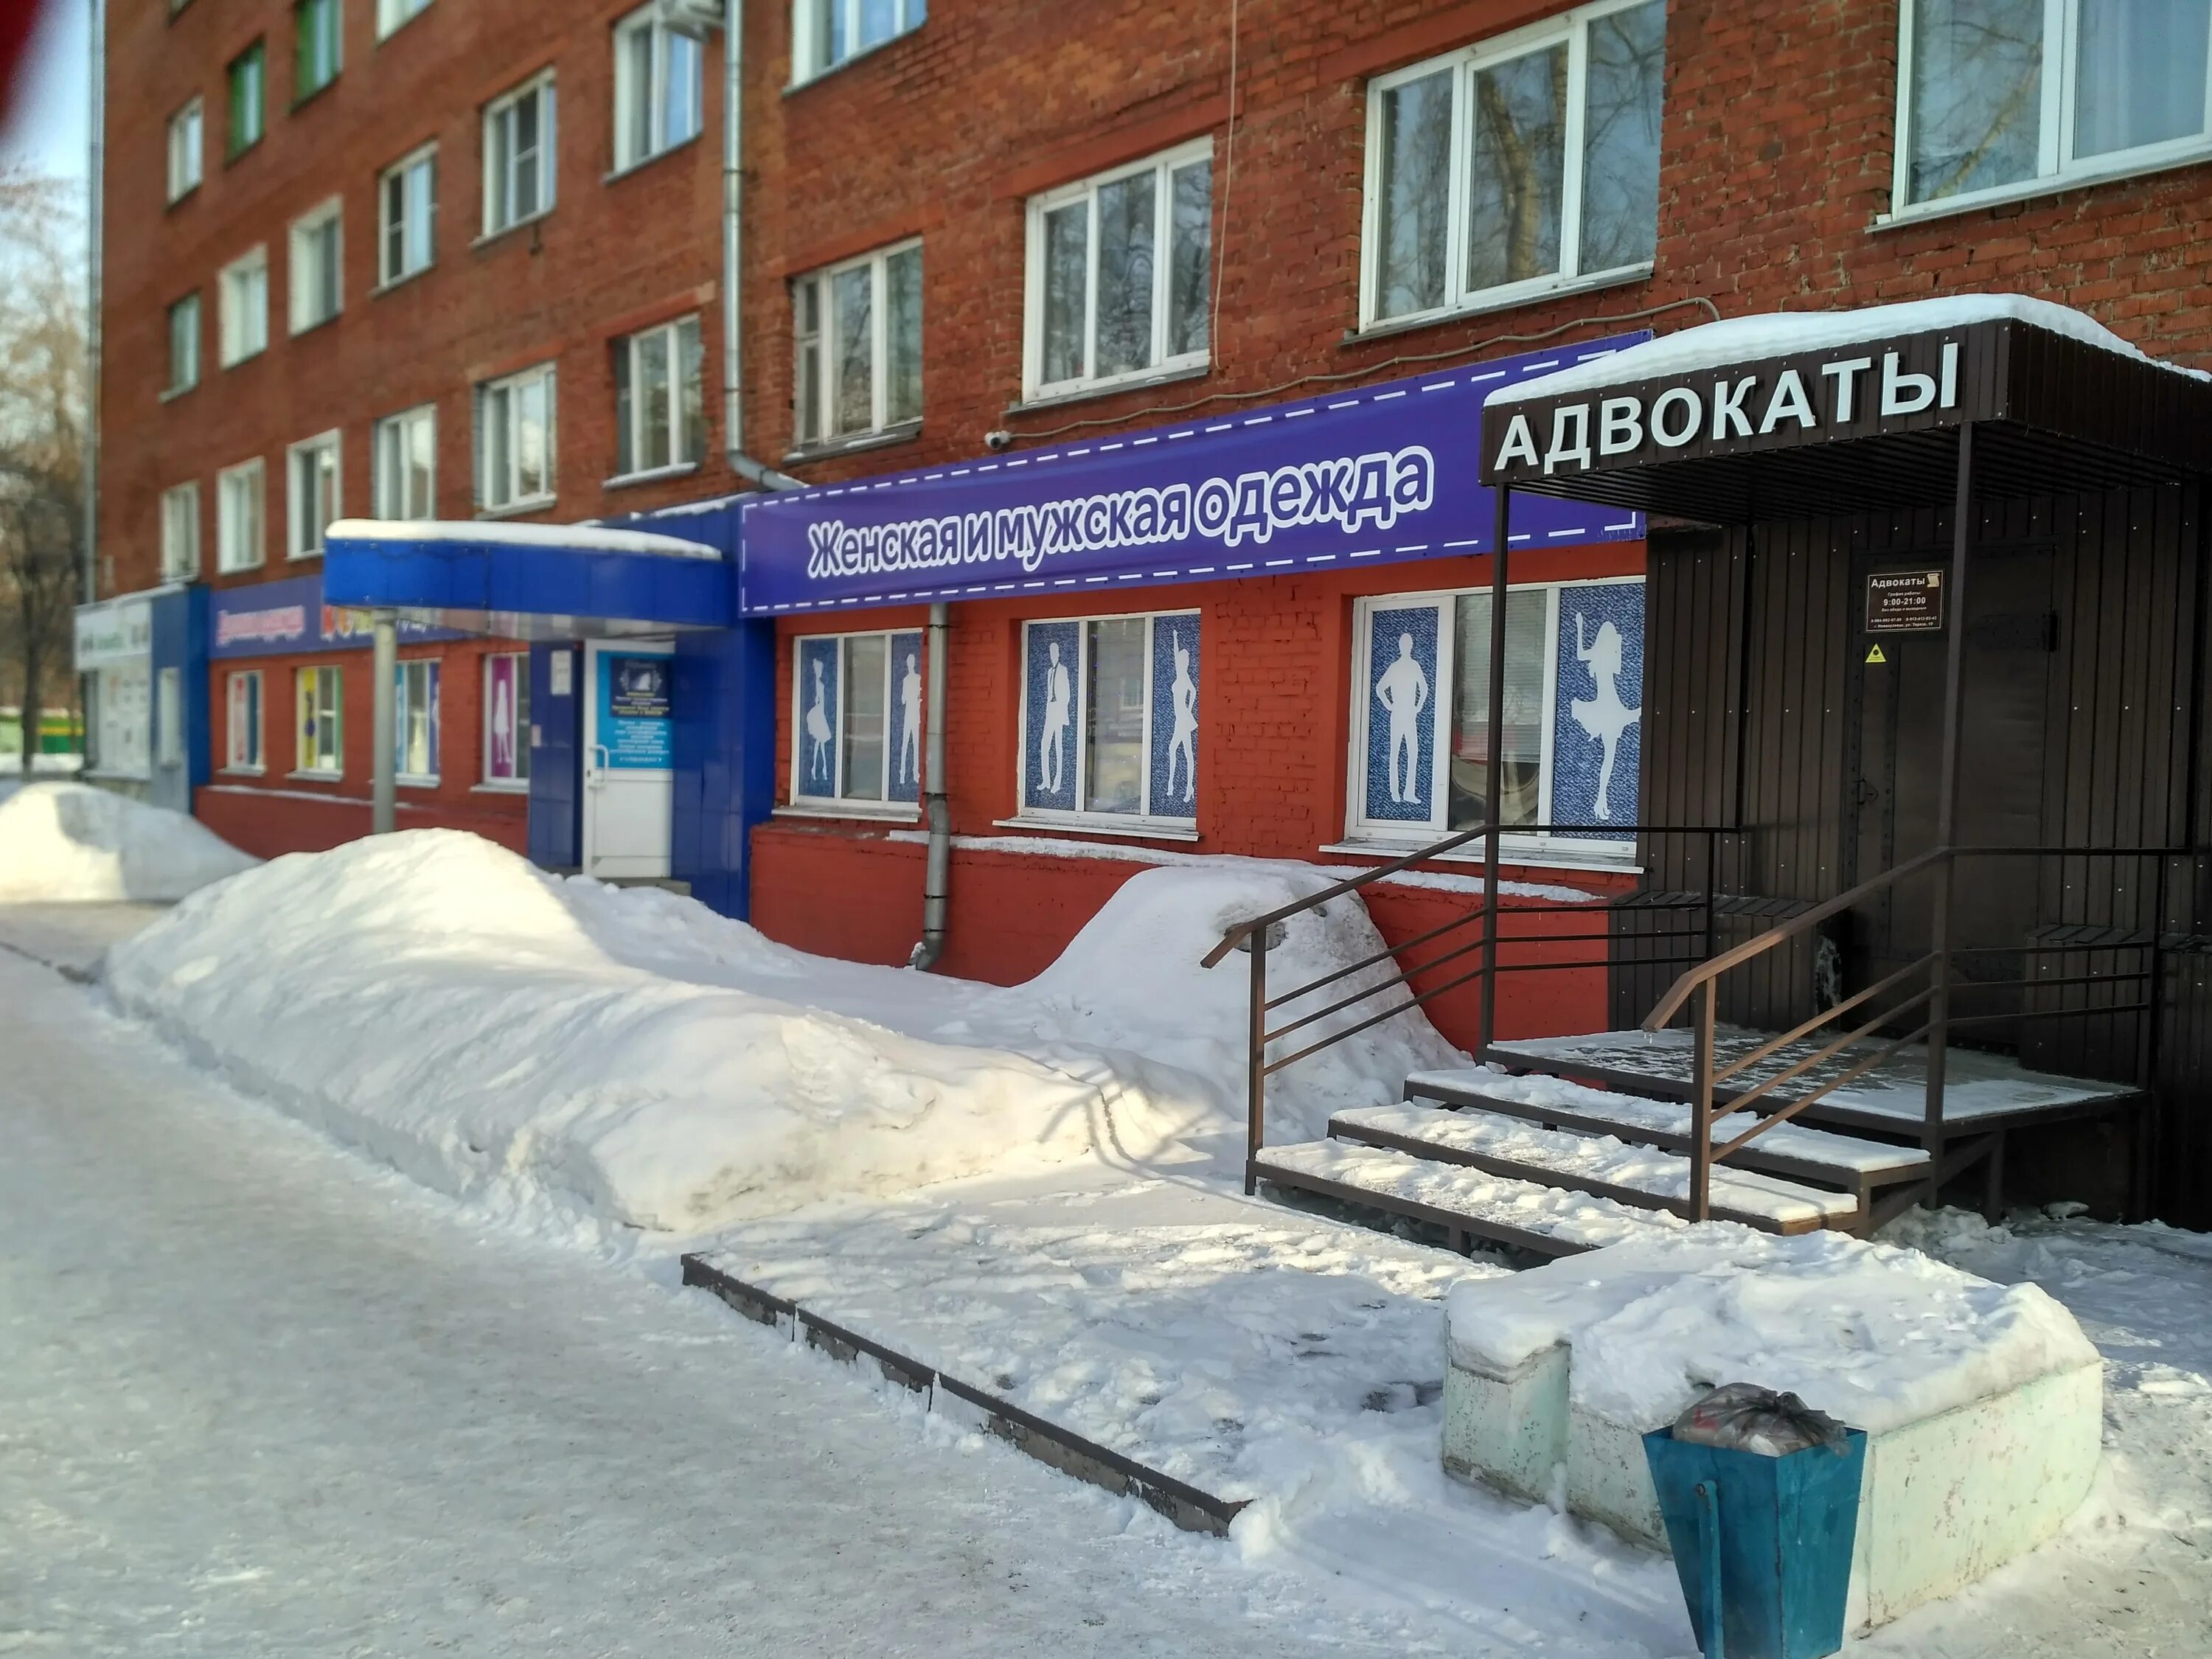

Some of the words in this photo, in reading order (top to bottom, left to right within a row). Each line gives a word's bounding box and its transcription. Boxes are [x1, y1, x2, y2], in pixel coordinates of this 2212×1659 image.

[1494, 342, 1960, 474] АДВОКАТЫ
[807, 518, 960, 578] Женская
[967, 510, 994, 563] и
[995, 483, 1186, 571] мужская
[1193, 445, 1435, 546] одежда
[1871, 577, 1925, 588] Адвокаты
[1883, 597, 1926, 606] 9:00-21:00
